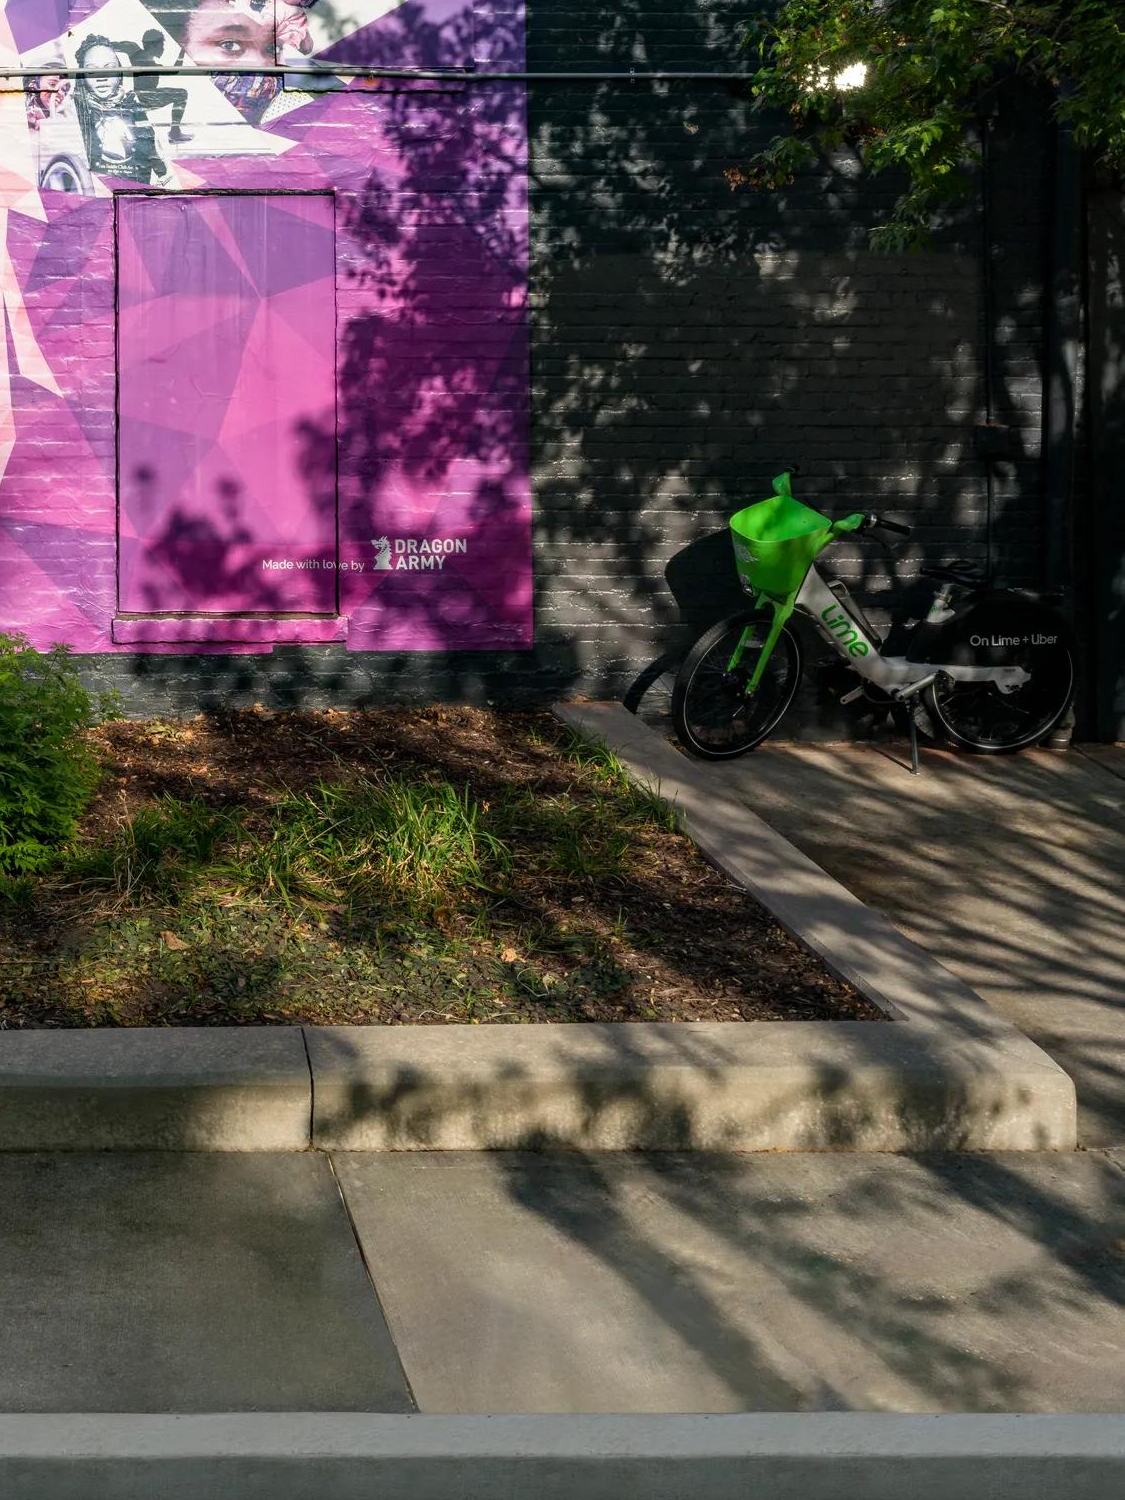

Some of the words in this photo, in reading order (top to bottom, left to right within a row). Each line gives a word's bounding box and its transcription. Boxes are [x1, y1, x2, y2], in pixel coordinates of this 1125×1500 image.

[395, 539, 467, 554] DRAGON
[262, 560, 294, 570] Made
[296, 560, 320, 570] with
[351, 560, 365, 573] by
[395, 555, 446, 570] ARMY
[821, 603, 869, 658] Lime
[970, 635, 989, 646] On
[991, 634, 1021, 646] Lime
[1031, 633, 1058, 645] Uber
